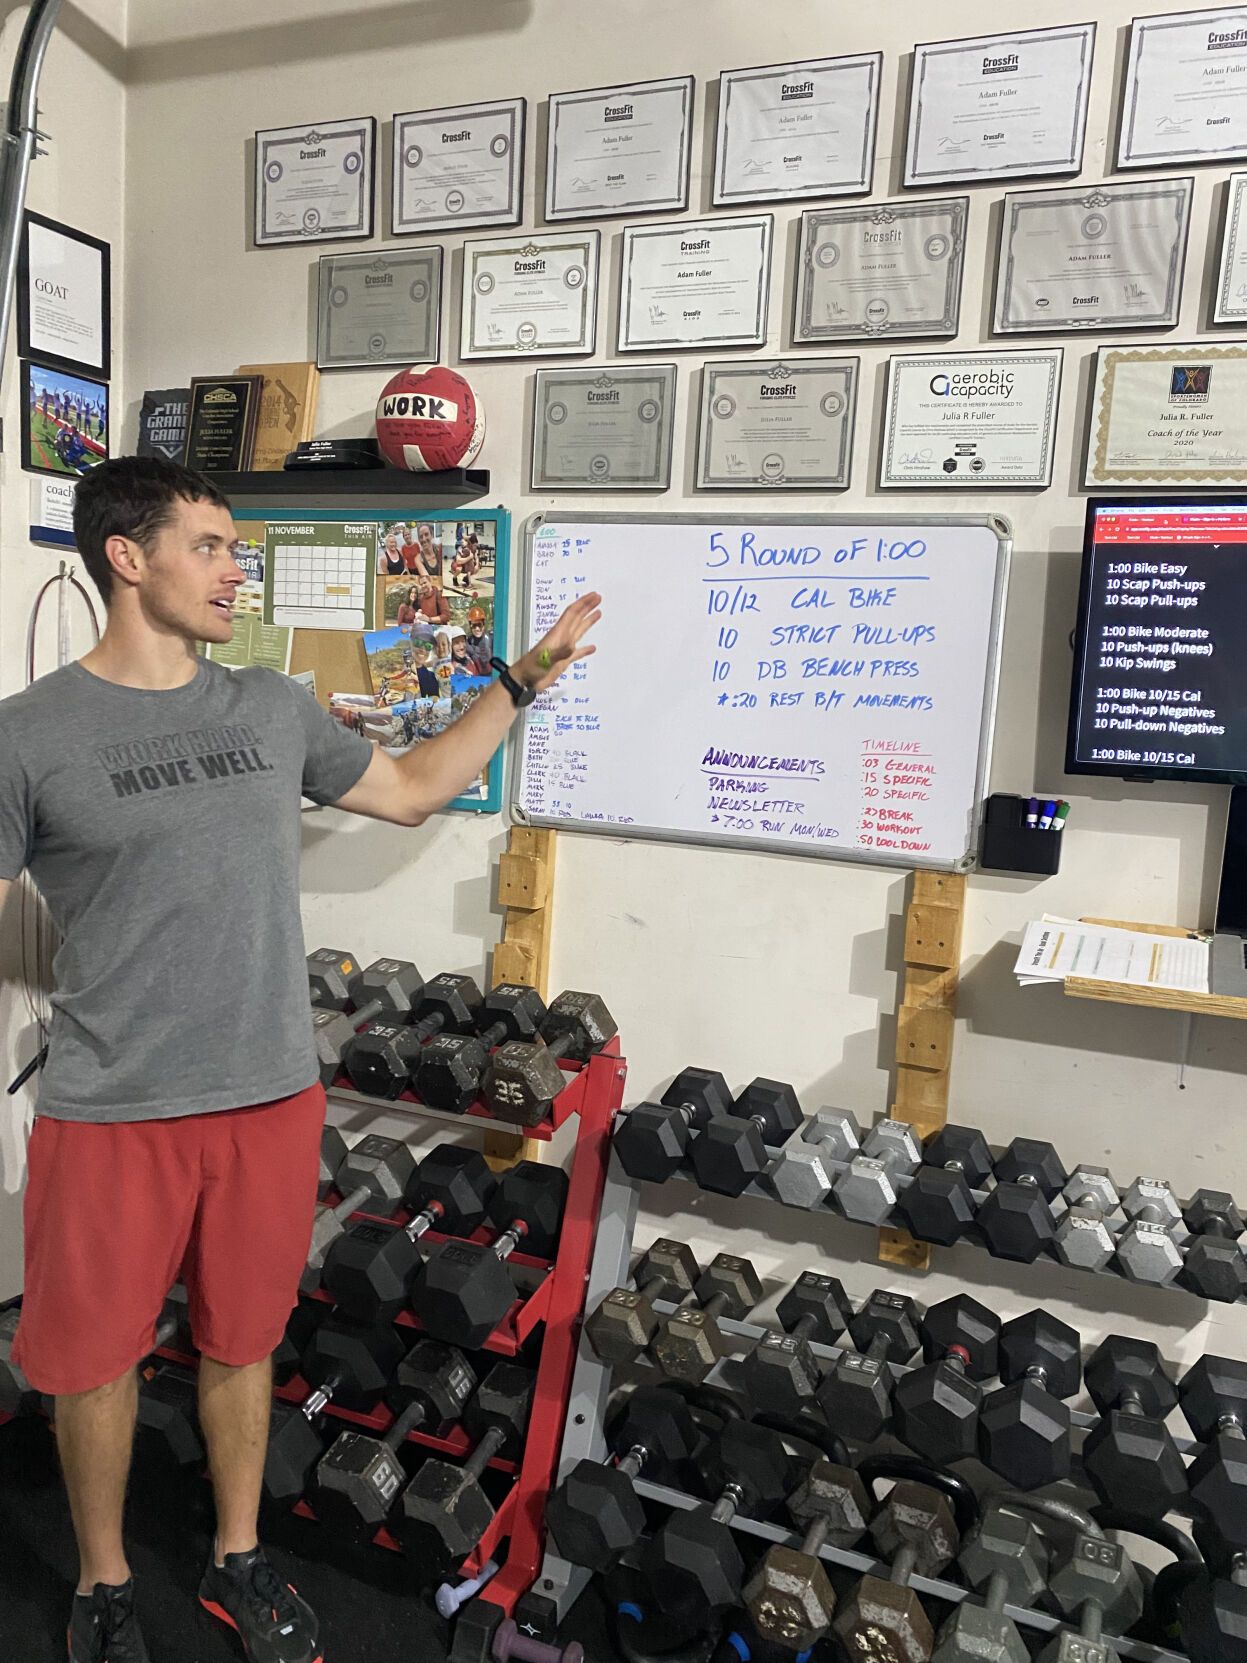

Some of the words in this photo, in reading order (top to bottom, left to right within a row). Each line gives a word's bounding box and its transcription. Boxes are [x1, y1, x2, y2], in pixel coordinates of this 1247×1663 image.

[983, 54, 1018, 67] CrossFit
[1203, 67, 1224, 76] Adam
[1226, 65, 1247, 74] Fuller
[782, 82, 813, 94] CrossFit
[979, 91, 998, 99] Adam
[1000, 89, 1018, 97] Fuller
[605, 104, 633, 116] CrossFit
[797, 113, 813, 122] Fuller
[1207, 117, 1230, 126] CrossFit
[442, 131, 471, 143] CrossFit
[602, 136, 616, 144] Adam
[618, 134, 633, 142] Fuller
[300, 149, 326, 159] CrossFit
[784, 155, 801, 163] CrossFit
[864, 230, 902, 242] CrossFit
[681, 240, 710, 251] CrossFit
[514, 260, 546, 271] CrossFit
[365, 274, 393, 284] CrossFit
[678, 270, 694, 278] Adam
[35, 278, 68, 300] GOAT
[1073, 296, 1099, 305] CrossFit
[952, 369, 1014, 384] aerobic
[588, 390, 619, 402] CrossFit
[760, 385, 797, 396] CrossFit
[951, 381, 1013, 399] capacity
[164, 402, 190, 415] THE
[384, 396, 446, 419] WORK
[942, 412, 960, 421] Julia
[972, 412, 995, 420] Fuller
[1175, 429, 1184, 438] of
[46, 485, 75, 498] coach
[275, 527, 314, 535] NOVEMBER
[707, 533, 729, 567] 5
[741, 533, 821, 566] ROUND
[877, 539, 927, 562] 1:00
[1108, 563, 1131, 574] 1:00
[1134, 563, 1158, 574] Bike
[1160, 564, 1186, 576] Easy
[1107, 579, 1120, 589] 10
[1122, 579, 1149, 591] Scap
[1152, 579, 1205, 591] Push-ups
[708, 586, 760, 615] 10/12
[791, 588, 835, 608] CAL
[849, 588, 897, 608] BIKE
[1105, 595, 1118, 605] 10
[1121, 595, 1148, 607] Scap
[1151, 595, 1198, 607] Pull-ups
[719, 628, 737, 649] 10
[770, 625, 842, 646] STRICT
[852, 623, 936, 646] PULL-UPS
[1103, 626, 1126, 636] 1:00
[1128, 626, 1152, 637] Bike
[1154, 627, 1208, 638] Moderate
[1102, 642, 1114, 652] 10
[1116, 642, 1169, 654] Push-ups
[1171, 643, 1213, 656] (knees)
[712, 660, 730, 682] 10
[758, 660, 786, 680] DB
[802, 658, 864, 679] BENCH
[870, 661, 919, 678] PRESS
[1100, 657, 1113, 667] 10
[1115, 658, 1133, 670] Kip
[1136, 658, 1176, 671] Swings
[769, 693, 804, 707] REST
[815, 690, 845, 711] B/T
[853, 694, 933, 711] MOVEMENTS
[1097, 688, 1120, 698] 1:00
[1123, 689, 1146, 700] Bike
[1149, 690, 1180, 702] 10/15
[1183, 690, 1201, 702] Cal
[1096, 703, 1109, 714] 10
[1112, 704, 1157, 717] Push-up
[1160, 705, 1215, 718] Negatives
[1095, 719, 1107, 728] 10
[1109, 719, 1166, 732] Pull-down
[1169, 722, 1224, 735] Negatives
[99, 733, 190, 771] WORK
[861, 739, 921, 752] TIMELINE
[702, 748, 825, 774] ANNOUNCEMENTS
[1092, 749, 1115, 760] 1:00
[1117, 750, 1141, 761] Bike
[1143, 752, 1174, 763] 10/15
[1176, 753, 1195, 764] Cal
[110, 760, 197, 797] MOVE
[197, 748, 273, 779] WELL.
[885, 760, 936, 774] GENERAL
[709, 777, 769, 793] PARKING
[883, 775, 932, 787] SPECIFIC
[884, 789, 930, 801] SPECIFIC
[707, 797, 805, 814] NEWSLETTER
[878, 807, 914, 821] BREAK
[760, 820, 784, 832] RUN
[790, 823, 839, 839] MON/WED
[877, 822, 923, 836] WORKOUT
